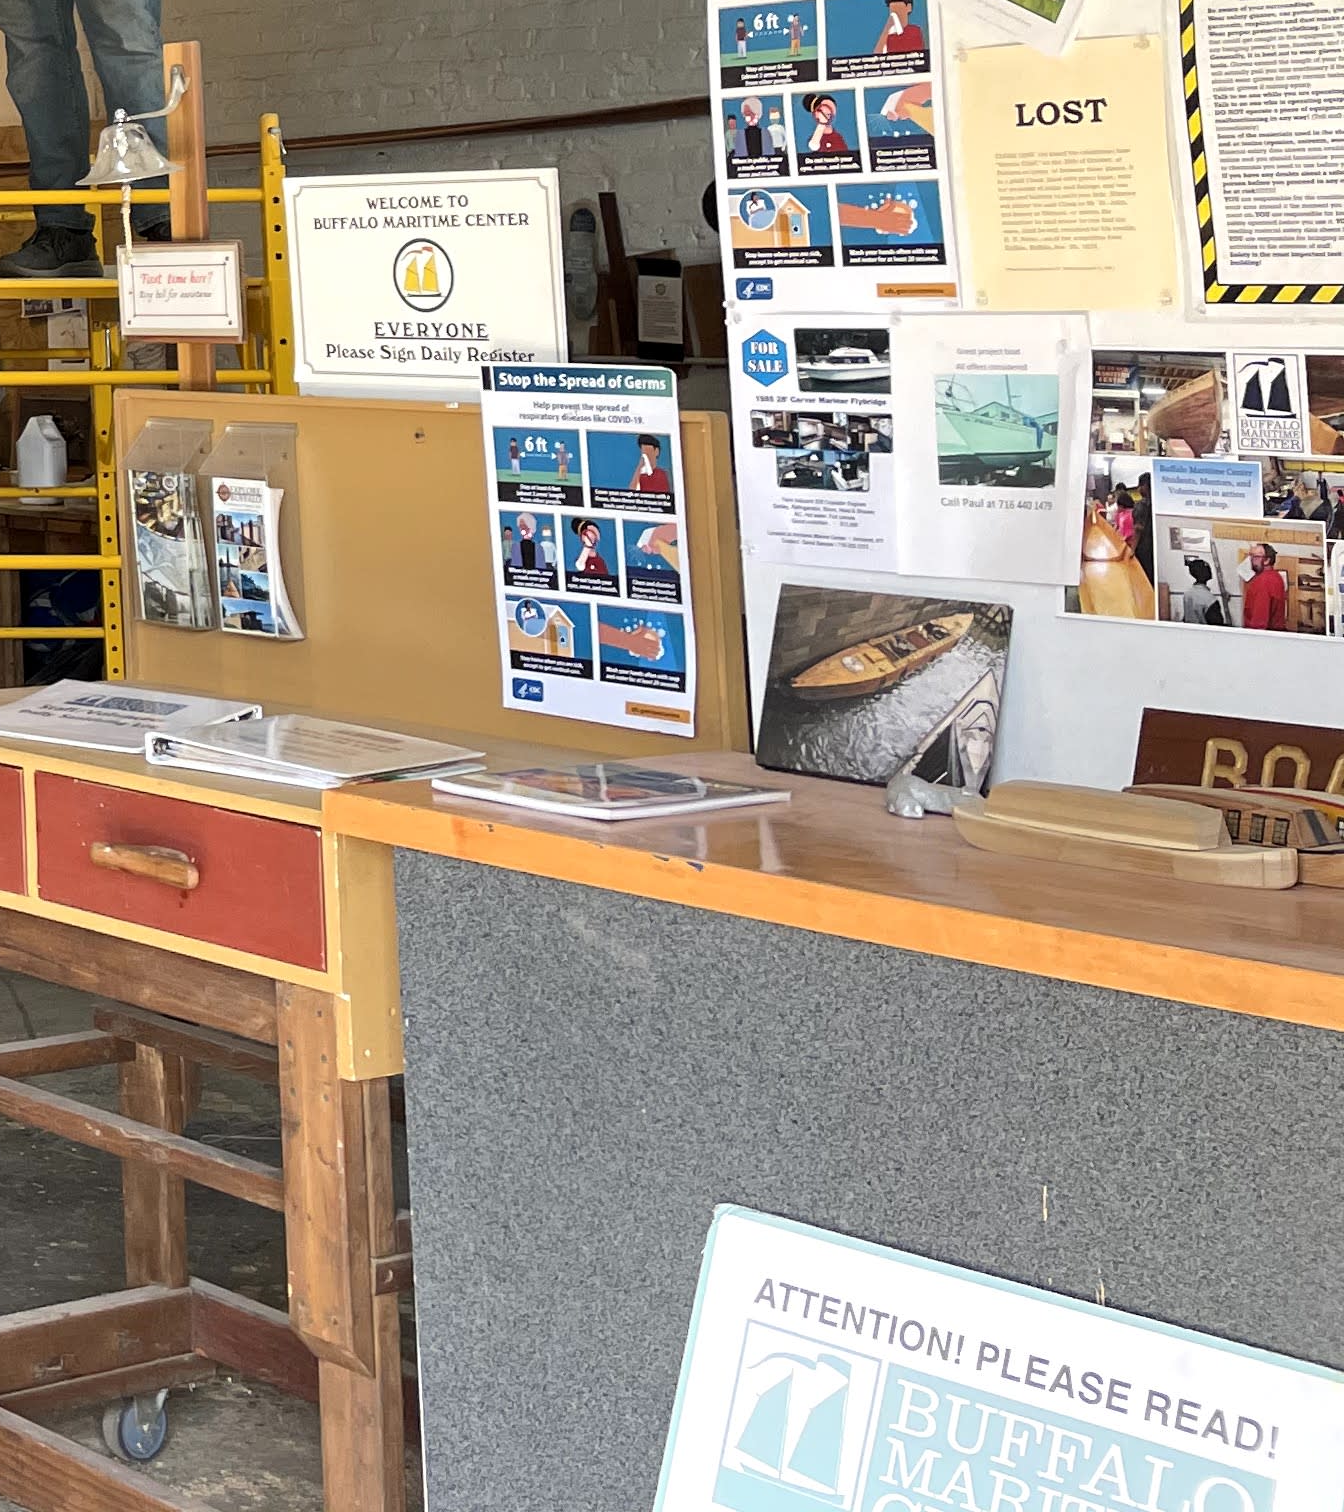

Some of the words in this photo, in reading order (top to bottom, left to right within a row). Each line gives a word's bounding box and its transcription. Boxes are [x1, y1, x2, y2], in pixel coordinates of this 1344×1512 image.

[753, 14, 764, 30] 6
[766, 13, 779, 29] ft
[1015, 98, 1108, 127] LOST
[366, 196, 443, 210] WELCOME
[448, 195, 468, 208] TO
[314, 217, 378, 229] BUFFALO
[383, 215, 460, 228] MARITIME
[465, 213, 529, 226] CENTER
[374, 322, 489, 338] EVERYONE
[326, 344, 374, 359] Please
[380, 345, 415, 362] Sign
[421, 346, 461, 362] Daily
[467, 347, 535, 362] Register
[750, 342, 778, 355] FOR
[747, 359, 784, 373] SALE
[499, 373, 531, 389] Stop
[534, 373, 556, 386] the
[559, 374, 605, 390] Spread
[608, 374, 622, 387] of
[624, 376, 666, 390] Germs
[533, 402, 550, 410] Help
[552, 403, 580, 411] prevent
[596, 404, 620, 412] spread
[622, 404, 629, 412] of
[1241, 419, 1300, 430] BUFFALO
[1241, 429, 1300, 438] MARITIME
[524, 437, 534, 451] 6
[536, 437, 547, 452] ft
[1240, 438, 1302, 450] CENTER
[941, 497, 960, 507] Call
[963, 498, 984, 508] Paul
[986, 500, 995, 508] at
[753, 1277, 963, 1366] ATTENTION!
[976, 1342, 1132, 1416] PLEASE
[1143, 1388, 1281, 1460] READ!
